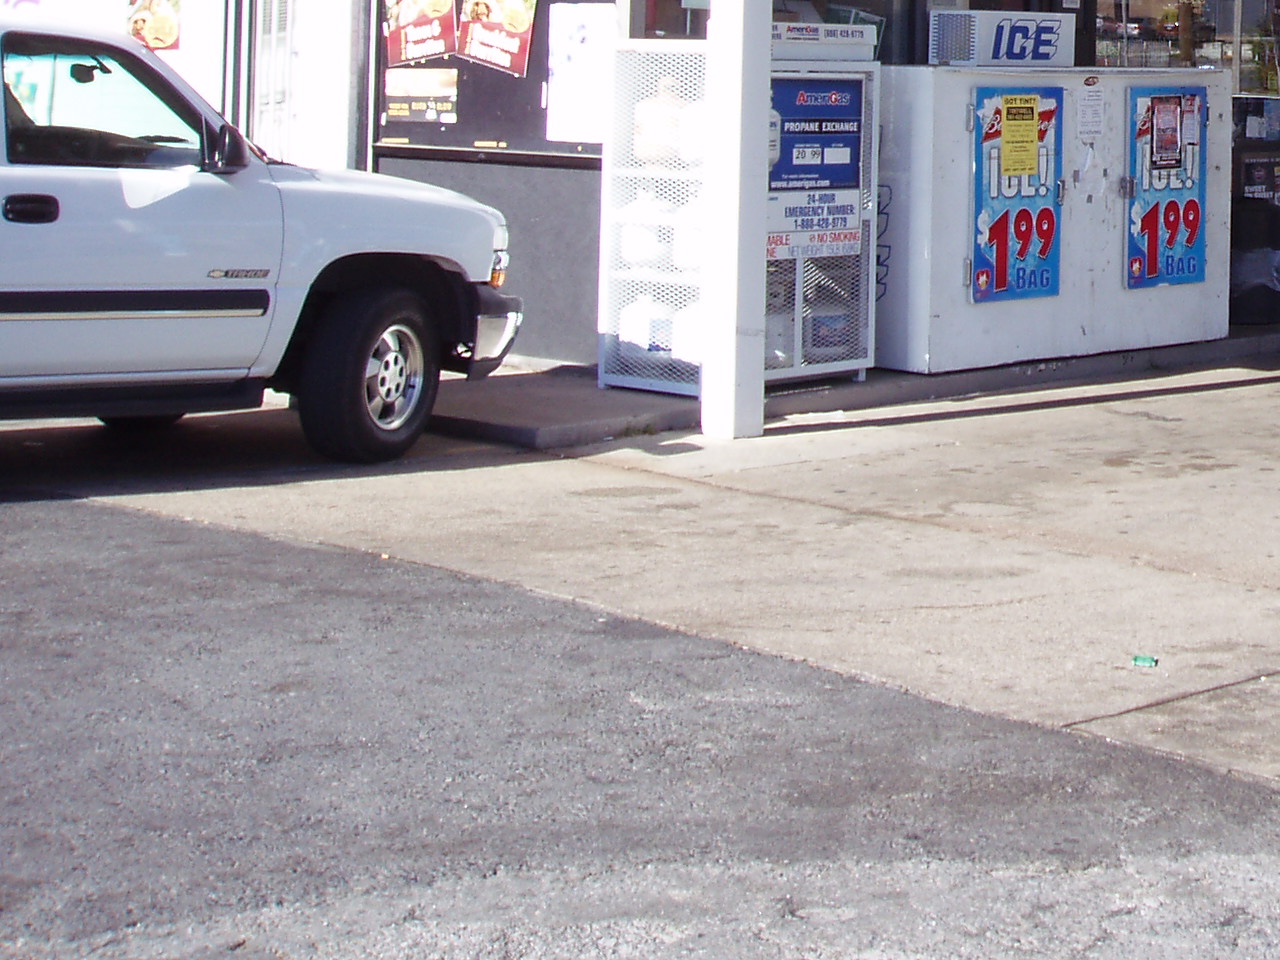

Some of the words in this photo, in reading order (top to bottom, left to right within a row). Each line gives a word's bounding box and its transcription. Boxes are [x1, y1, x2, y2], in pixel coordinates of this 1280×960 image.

[991, 18, 1062, 60] ICE
[796, 91, 850, 106] AmeriGas
[784, 121, 820, 132] PROPANE
[822, 121, 859, 132] EXCHANGE
[817, 233, 828, 244] NO
[829, 231, 860, 243] SMOKING
[1165, 254, 1197, 277] BAG
[1016, 267, 1051, 290] BAG
